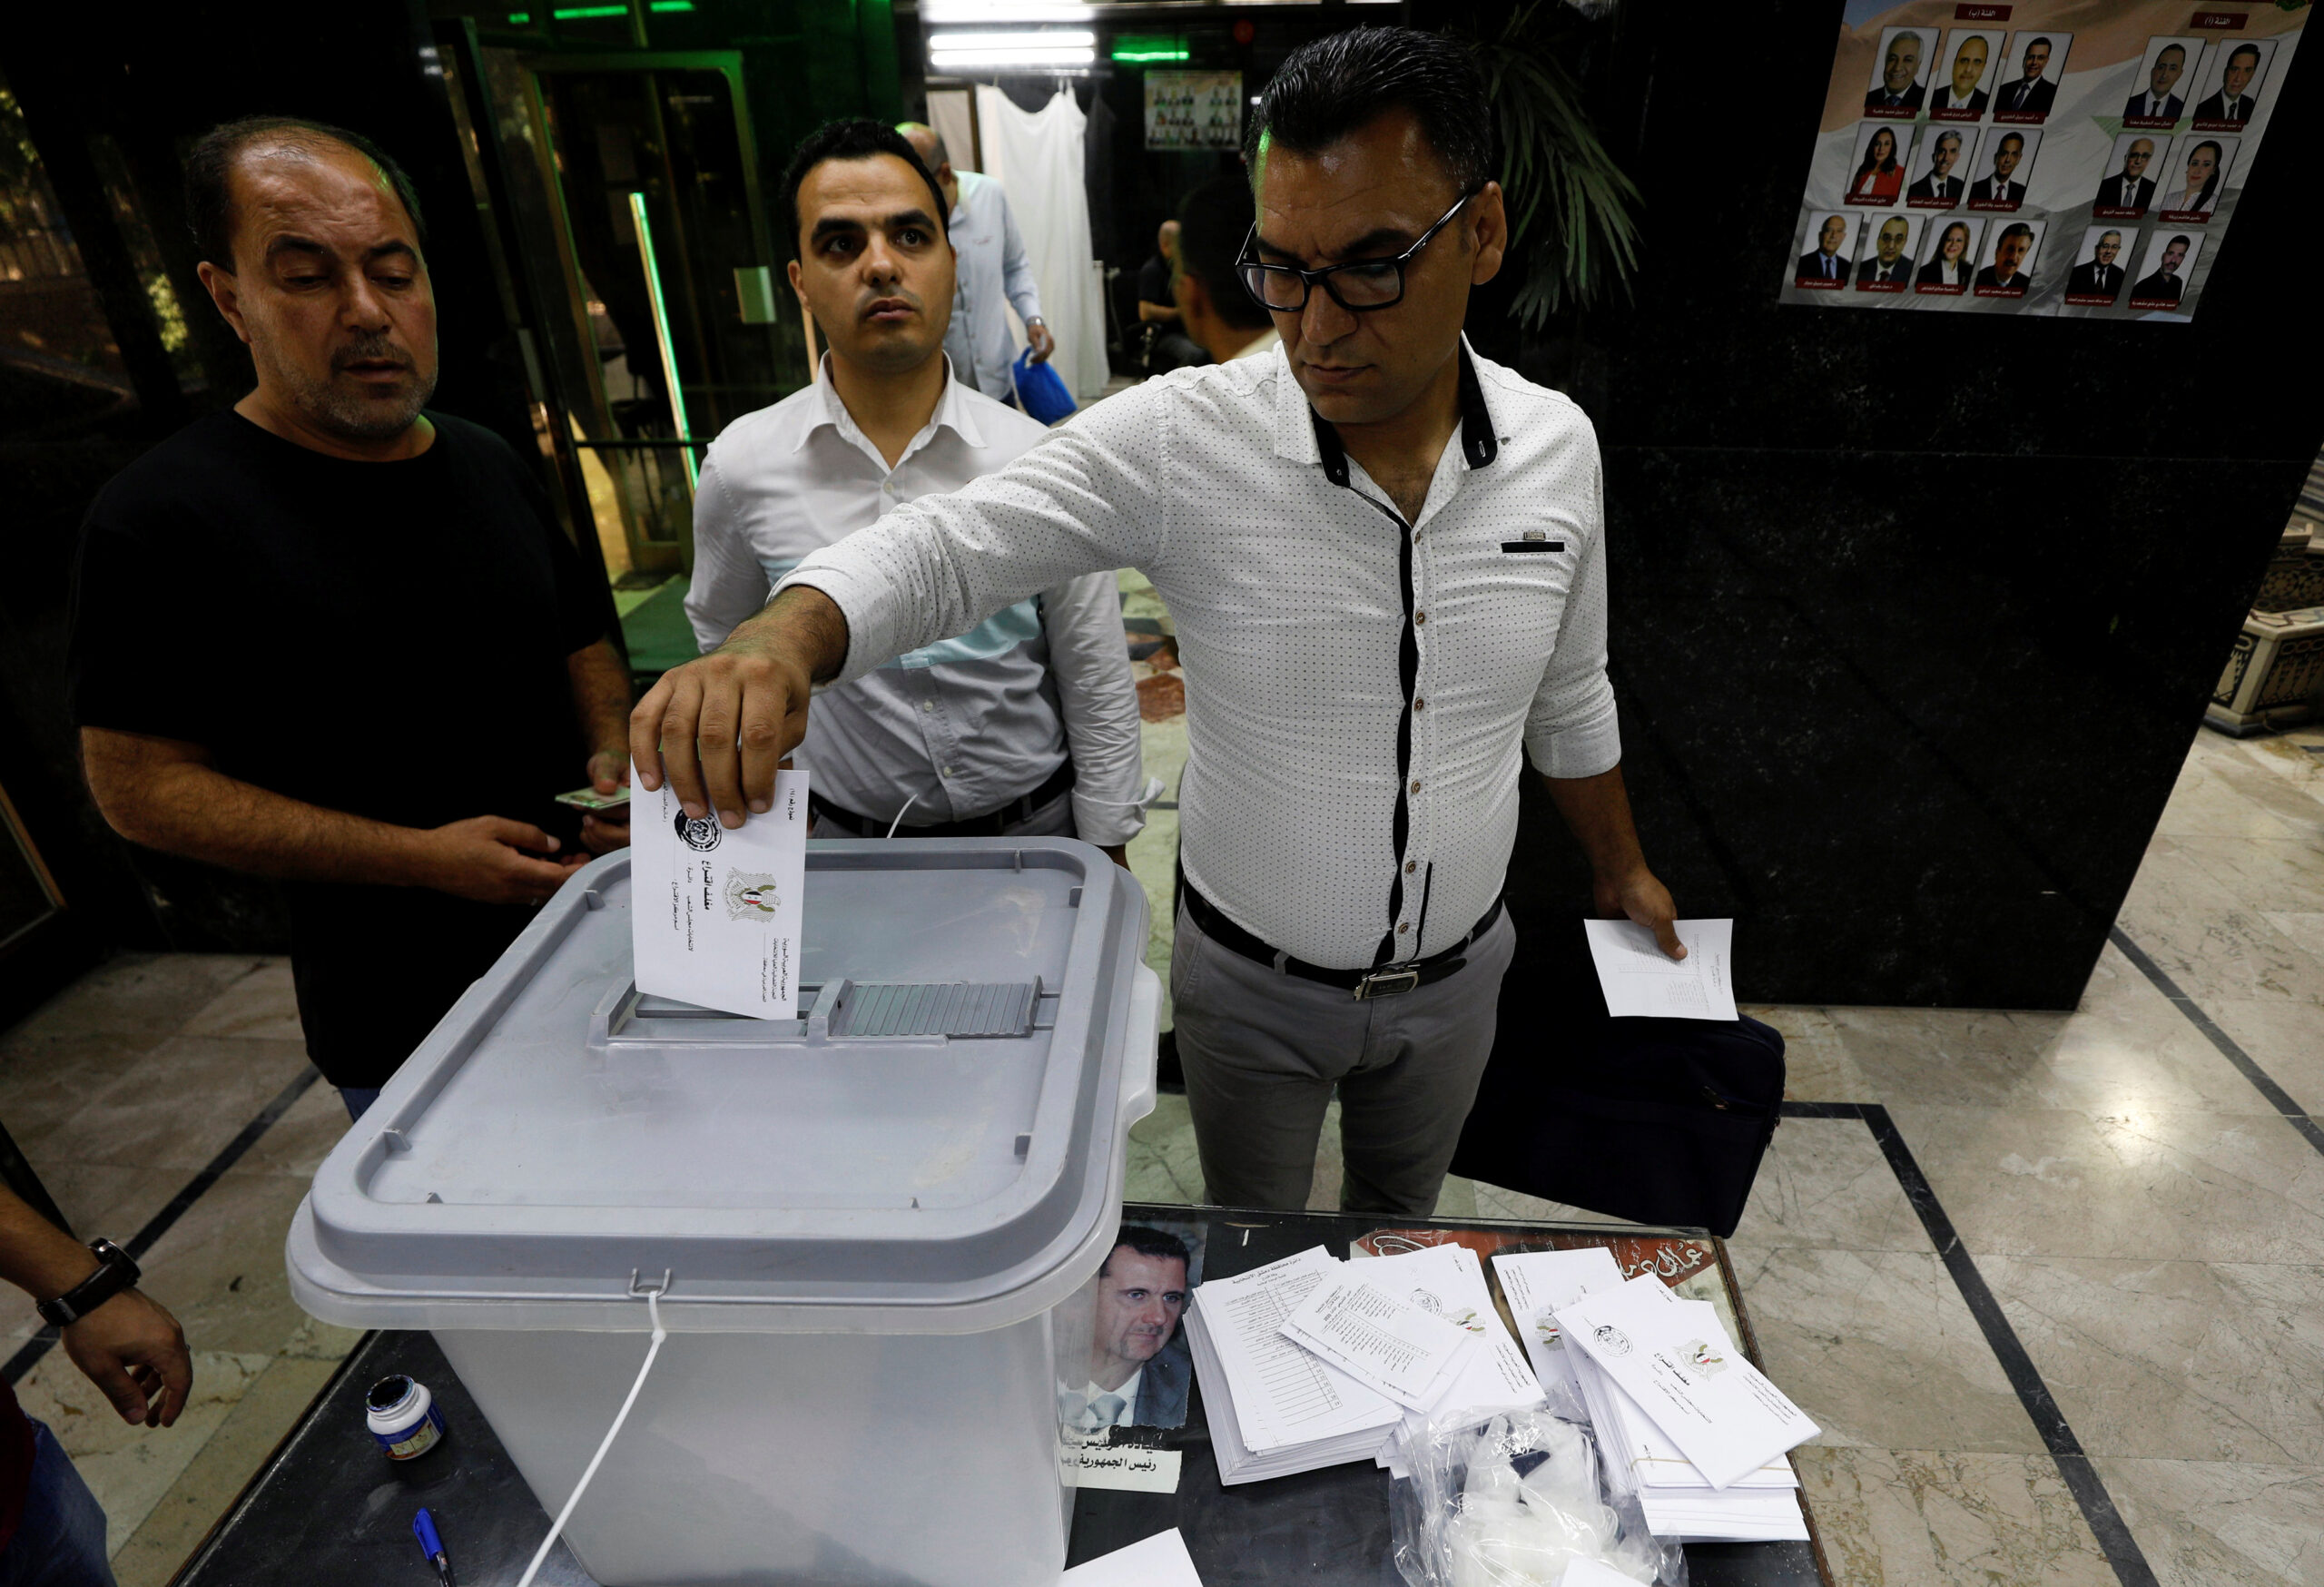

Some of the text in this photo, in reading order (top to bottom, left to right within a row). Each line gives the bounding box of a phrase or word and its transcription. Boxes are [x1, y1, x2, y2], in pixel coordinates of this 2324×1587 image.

[787, 798, 795, 806] رقم
[671, 881, 679, 902] الاقتراع
[701, 860, 713, 910] مغلف اقتراع
[781, 938, 789, 958] السورية
[1271, 1261, 1289, 1271] محافظة
[1654, 1351, 1690, 1385] مغلف اقتراع
[1079, 1454, 1128, 1470] الجمهورية
[1128, 1458, 1157, 1472] رئيس
